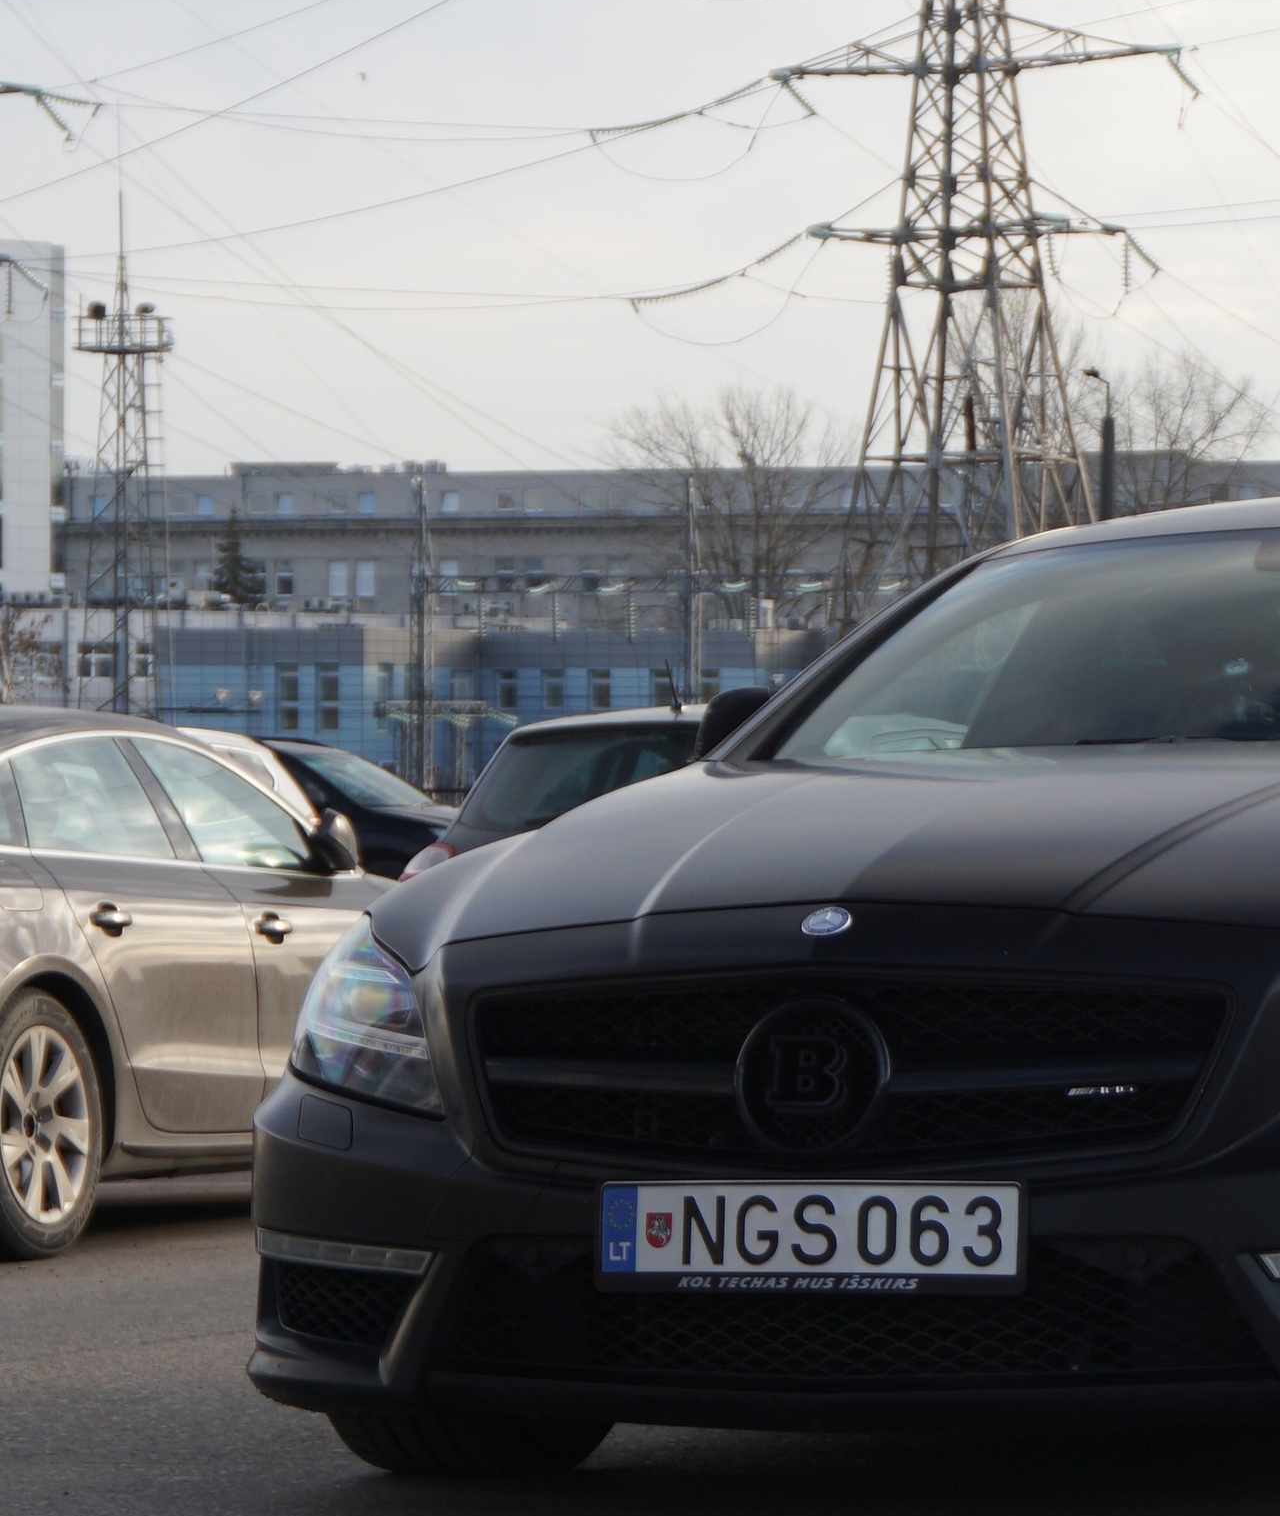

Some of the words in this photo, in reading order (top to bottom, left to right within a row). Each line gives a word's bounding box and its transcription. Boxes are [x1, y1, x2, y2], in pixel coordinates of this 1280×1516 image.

[765, 1034, 848, 1113] B
[609, 1241, 631, 1261] LT
[678, 1276, 712, 1288] KOL
[717, 1276, 789, 1289] TECHAS
[793, 1277, 835, 1289] MUS
